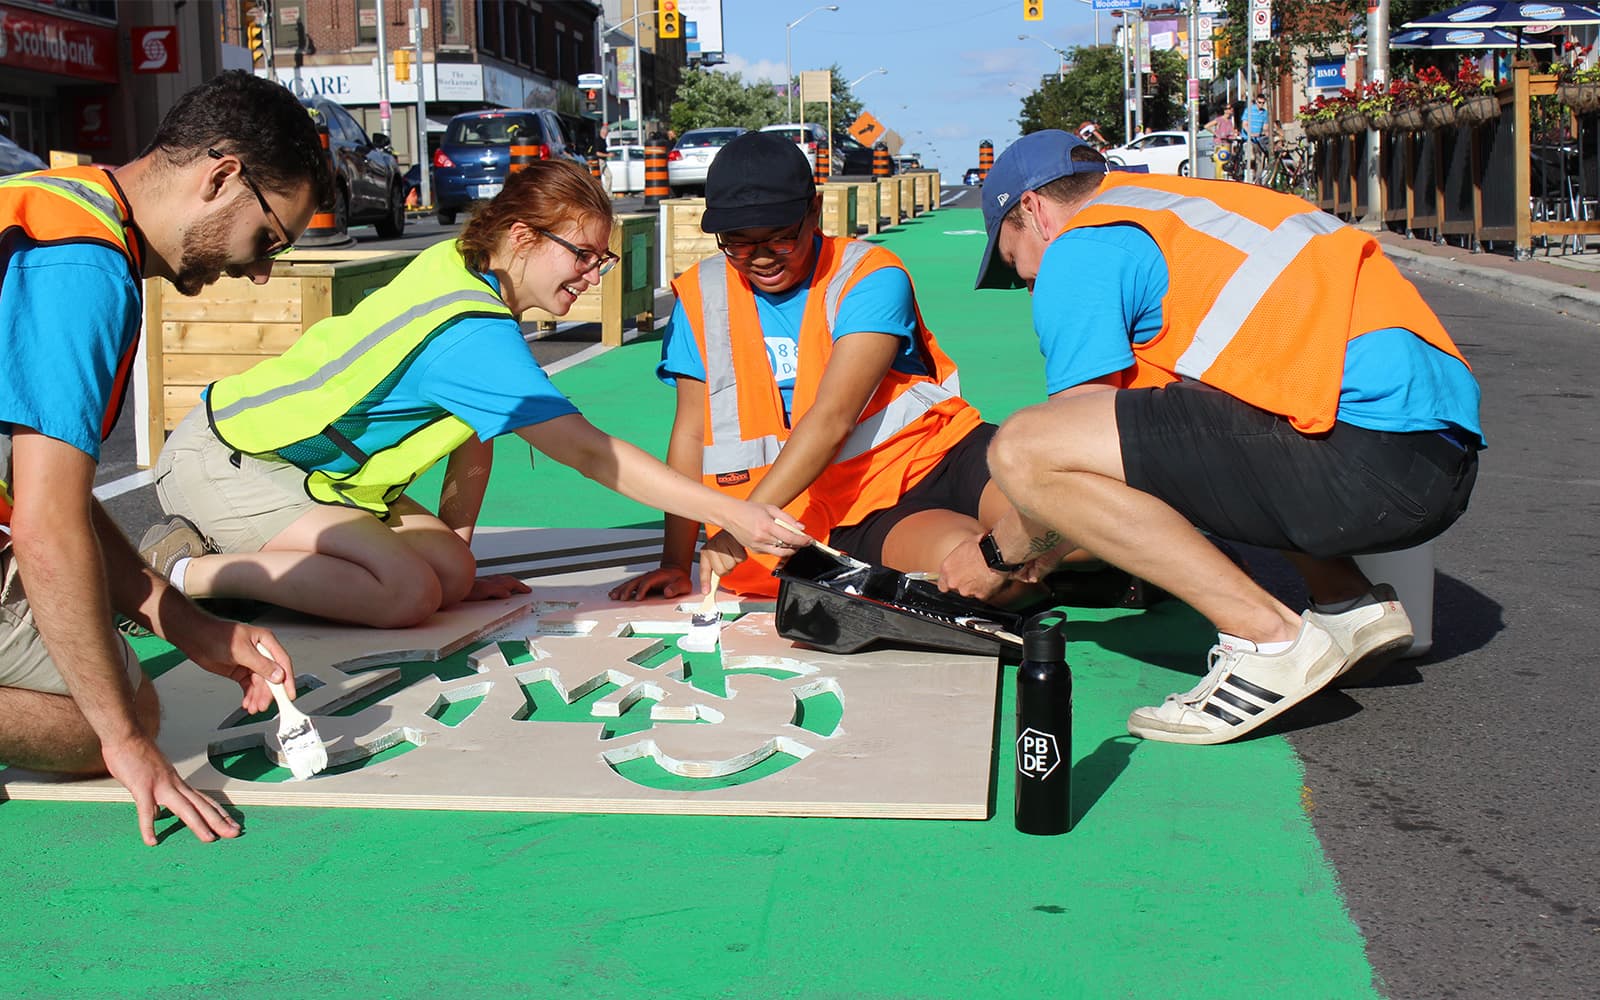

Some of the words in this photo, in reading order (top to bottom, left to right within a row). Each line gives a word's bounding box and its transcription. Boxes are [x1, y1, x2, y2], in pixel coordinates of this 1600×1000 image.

[13, 23, 96, 66] Scotiabank
[1317, 68, 1338, 78] BMO
[1023, 736, 1048, 754] PB
[1024, 754, 1048, 771] DE
